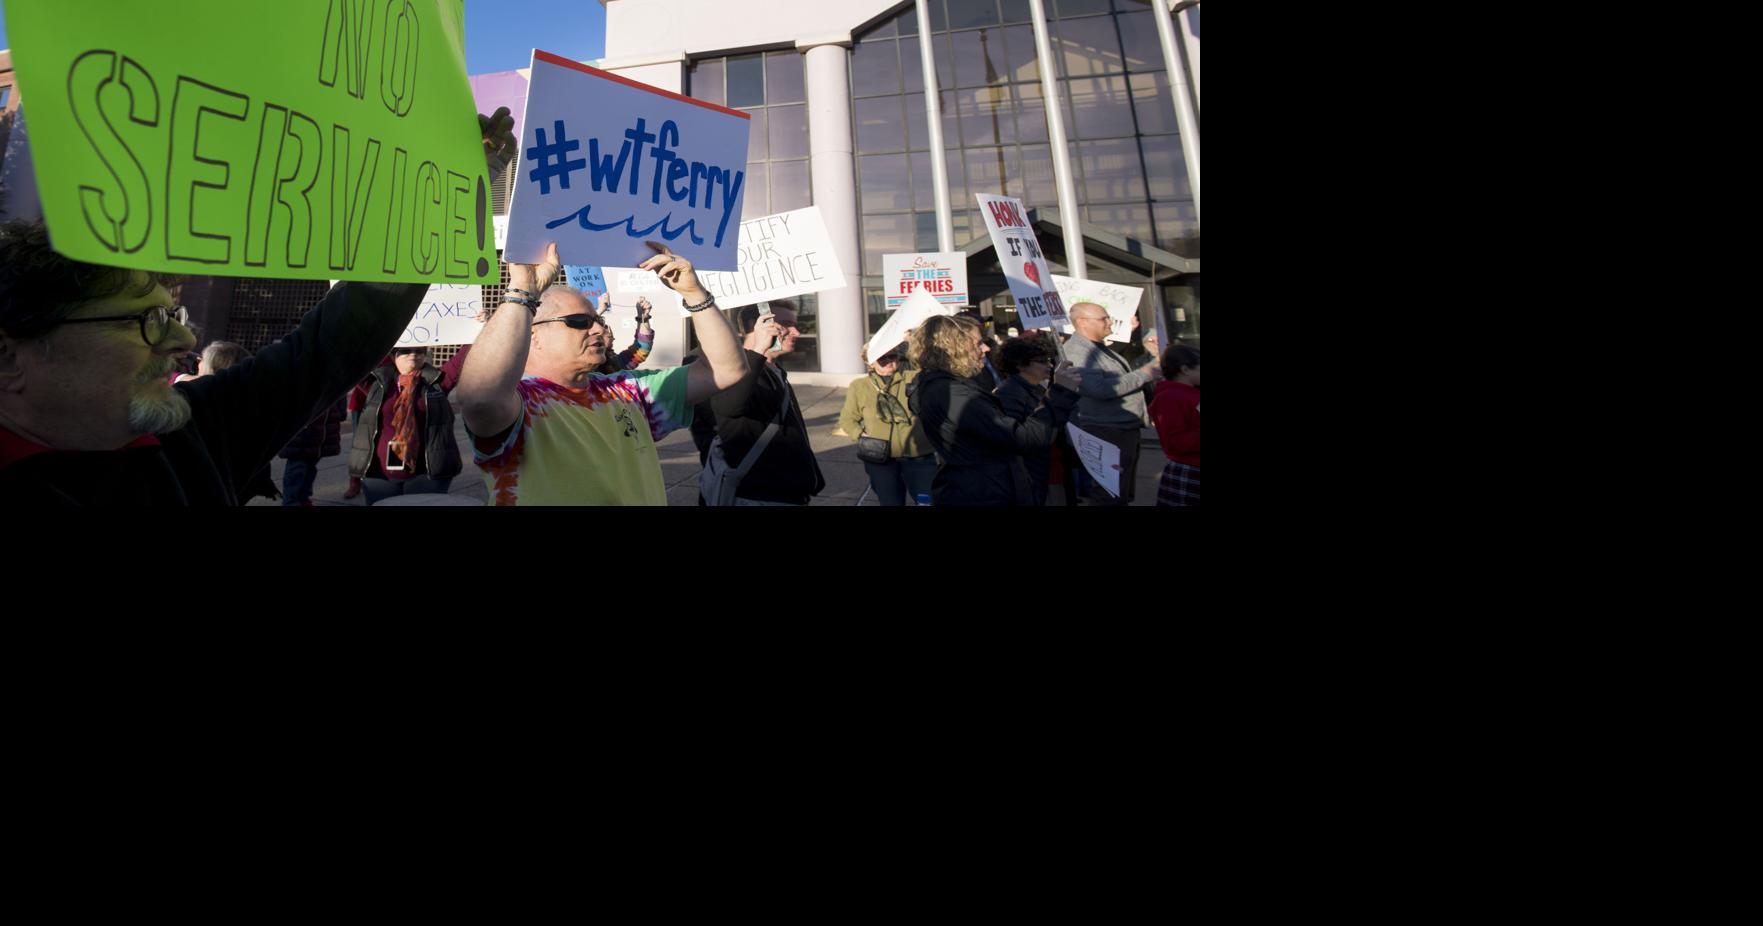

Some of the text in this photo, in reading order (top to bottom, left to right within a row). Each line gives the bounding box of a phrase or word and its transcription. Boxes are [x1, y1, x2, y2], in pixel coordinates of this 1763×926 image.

[319, 0, 420, 118] NO
[67, 48, 490, 279] SERVICE!
[526, 117, 744, 249] #wtferry
[987, 201, 1027, 228] HONK
[740, 214, 791, 243] TIFY
[739, 242, 782, 266] OUR
[1006, 237, 1022, 256] IF
[578, 267, 591, 275] AT
[912, 256, 939, 268] Save
[572, 274, 600, 282] WORK
[916, 269, 937, 280] THE
[1018, 296, 1047, 318] THE
[399, 321, 440, 344] OO!
